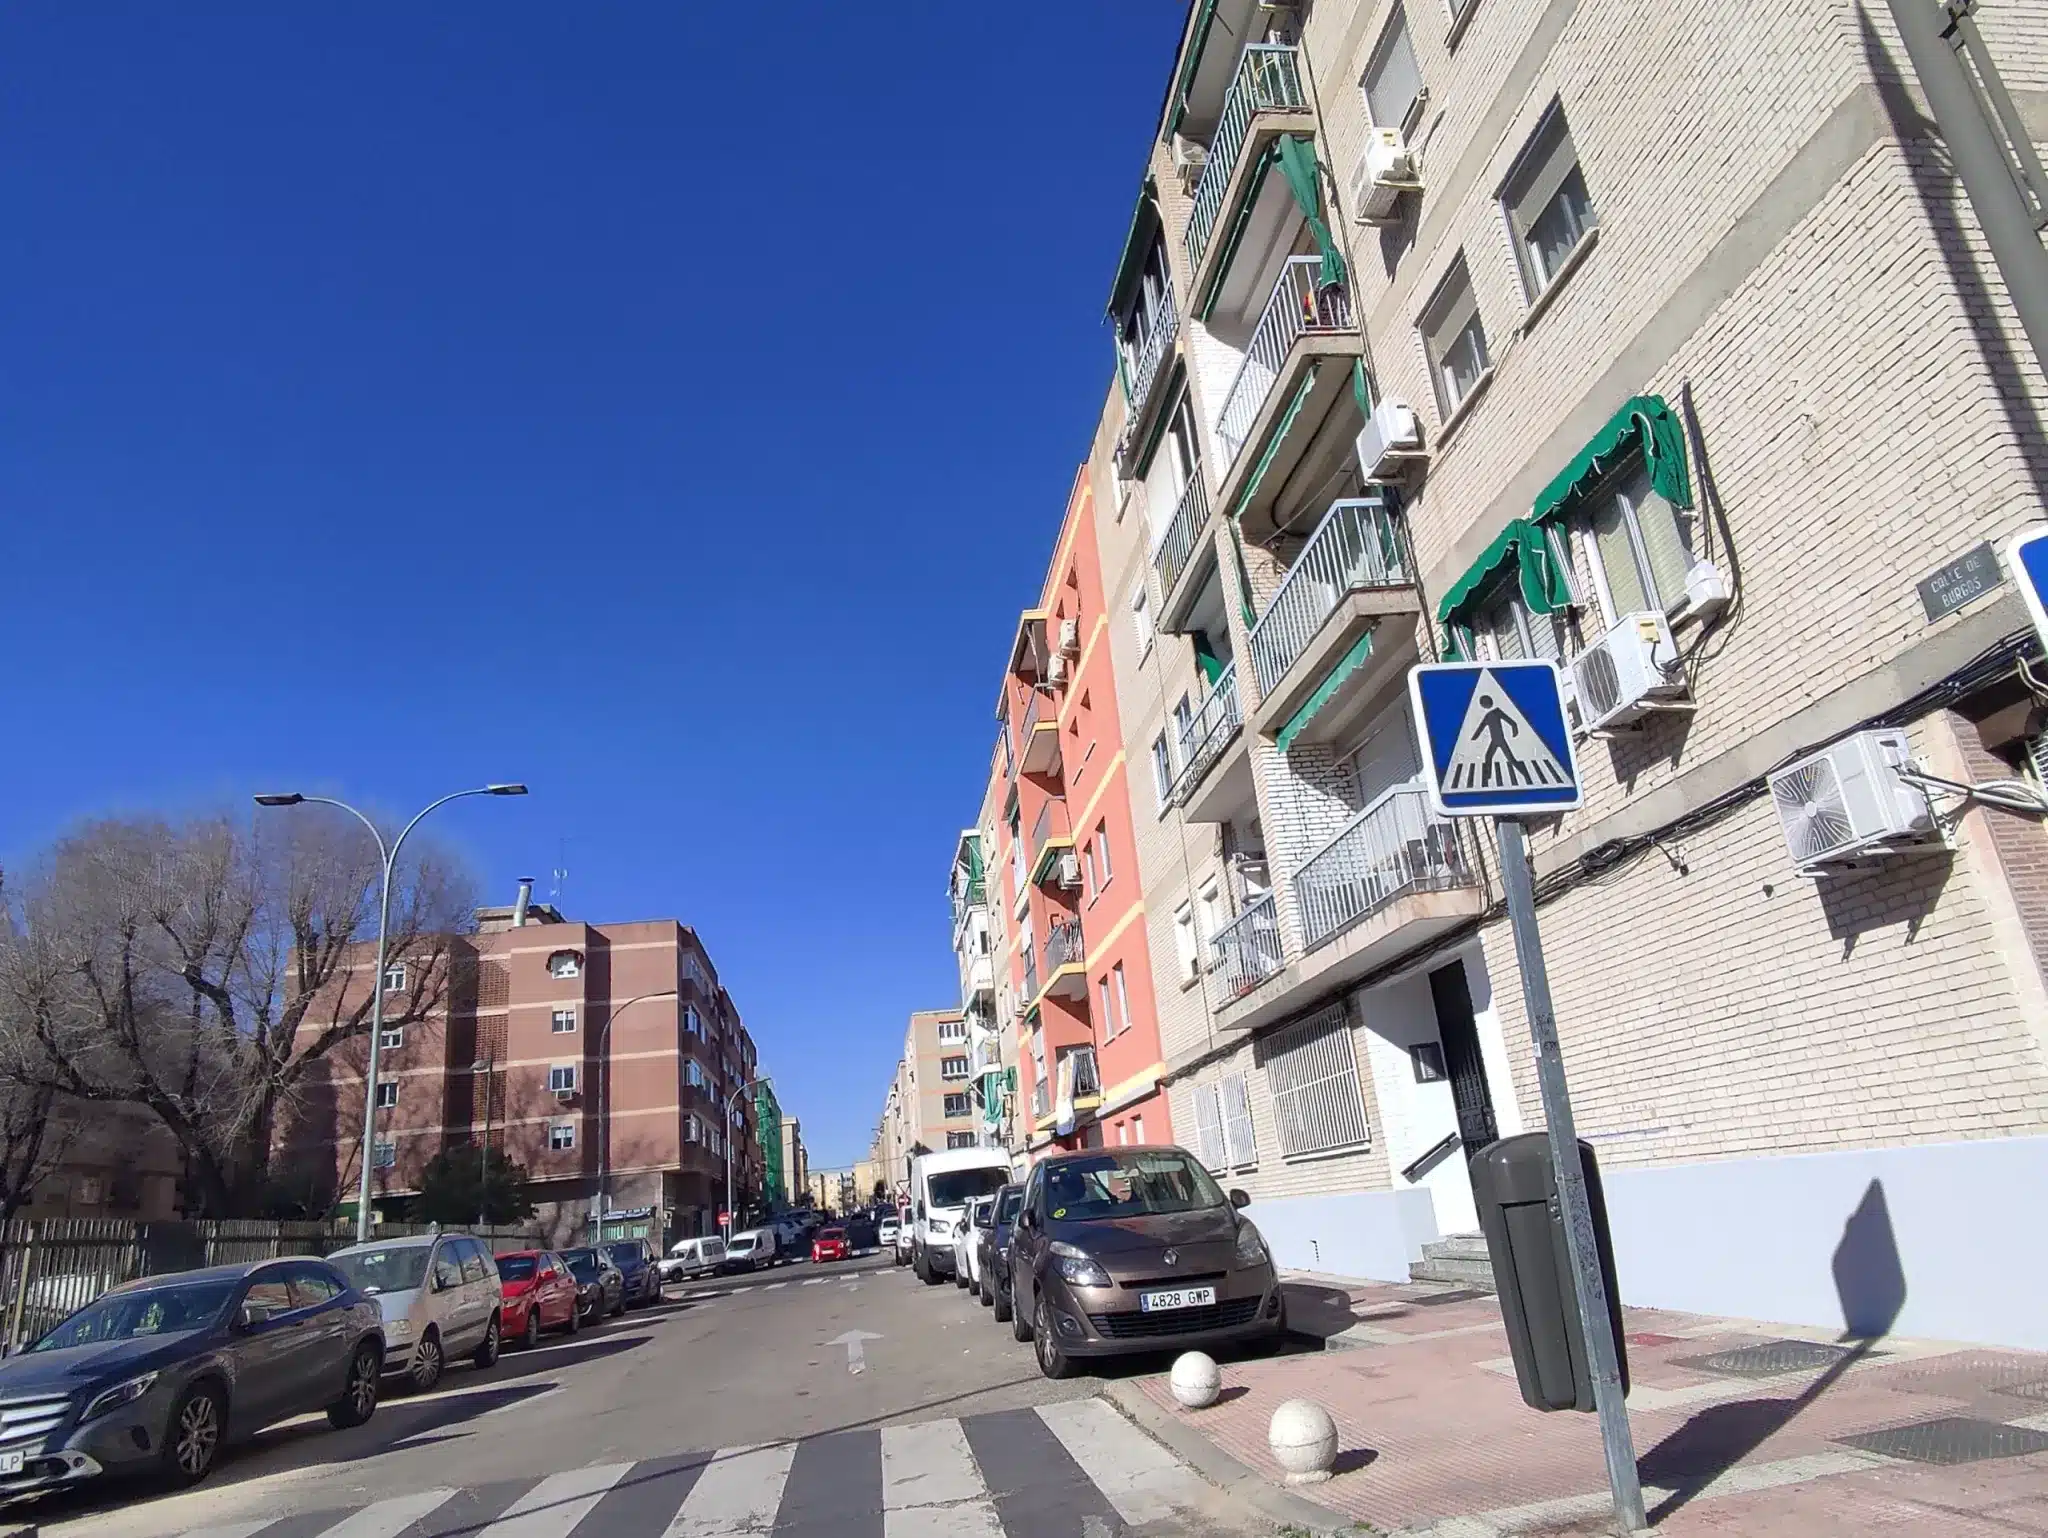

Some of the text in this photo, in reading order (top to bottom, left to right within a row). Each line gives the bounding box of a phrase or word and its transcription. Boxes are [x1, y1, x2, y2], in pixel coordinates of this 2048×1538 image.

[1931, 556, 1981, 593] CALLE DE
[1941, 577, 1982, 607] BURGOS
[1152, 1289, 1210, 1307] 4828 GWP
